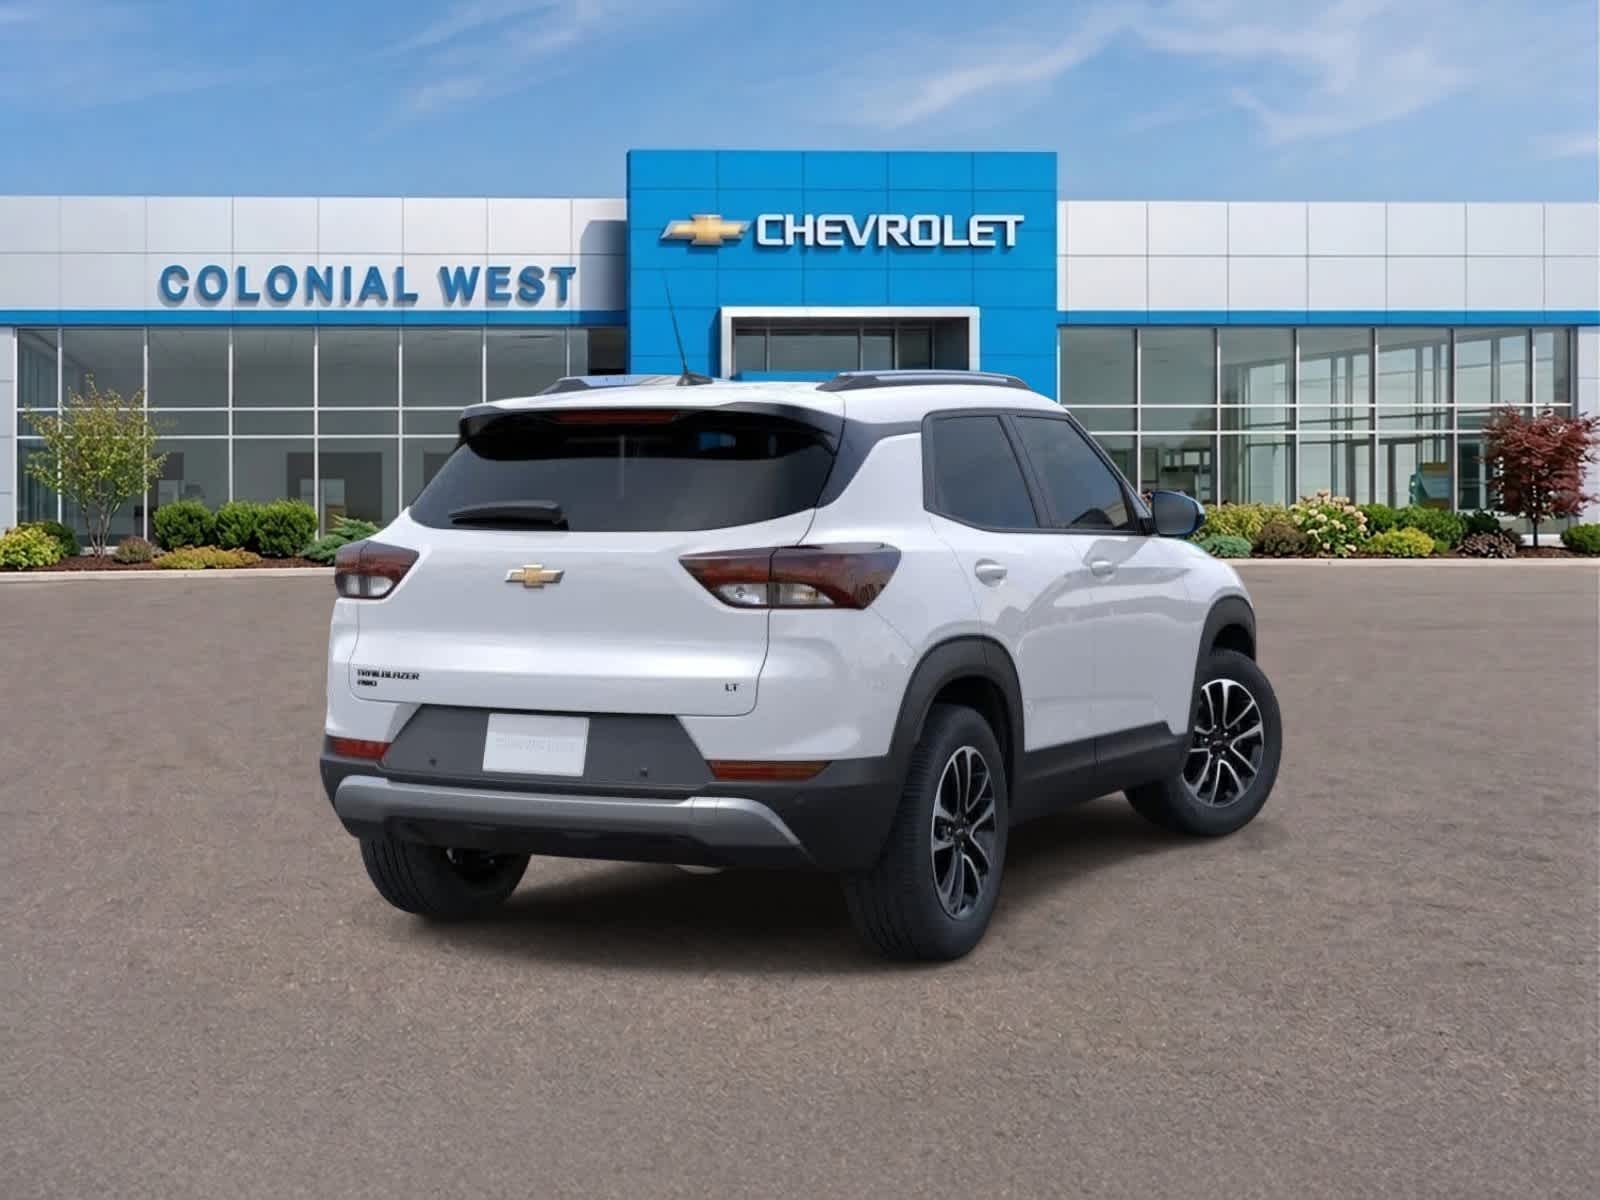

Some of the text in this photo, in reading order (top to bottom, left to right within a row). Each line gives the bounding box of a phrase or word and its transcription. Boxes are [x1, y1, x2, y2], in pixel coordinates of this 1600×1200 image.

[756, 213, 1025, 247] CHEVROLET
[160, 265, 577, 304] COLONIAL WEST
[356, 669, 420, 680] TRAILBLAZER
[725, 683, 740, 692] LT
